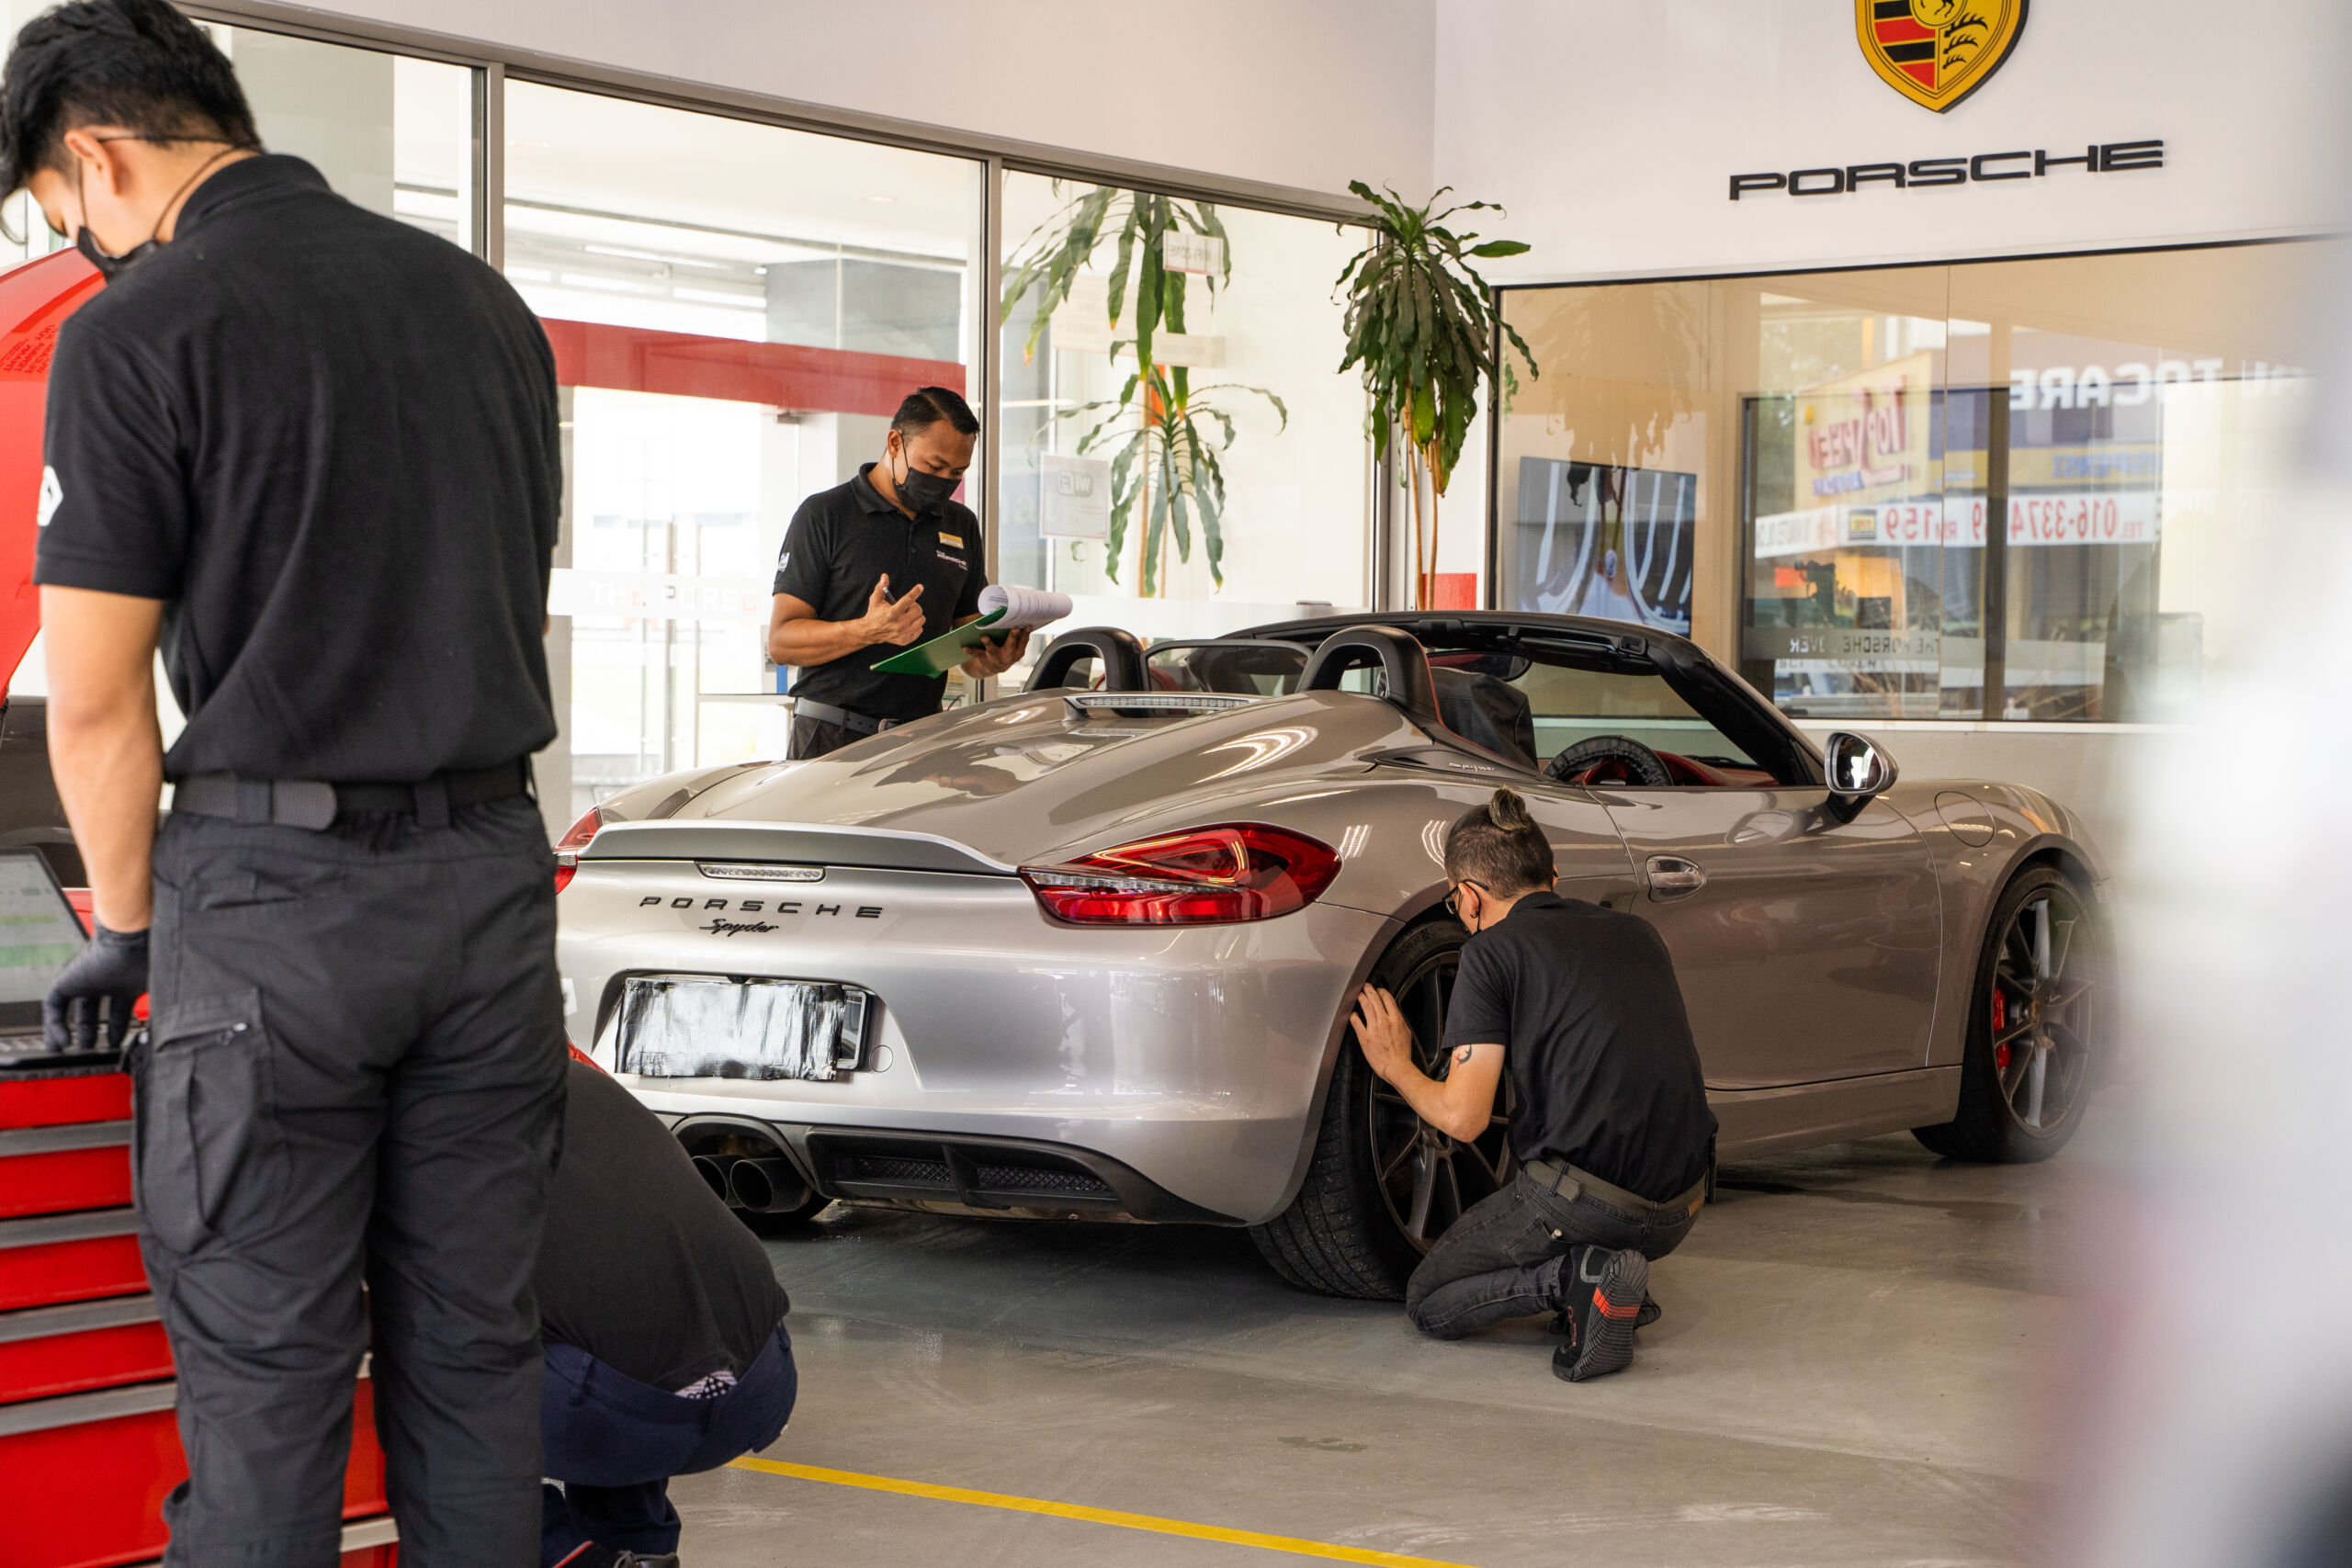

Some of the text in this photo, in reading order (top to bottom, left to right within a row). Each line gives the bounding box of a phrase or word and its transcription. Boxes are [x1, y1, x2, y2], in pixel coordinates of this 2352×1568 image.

[1729, 140, 2164, 200] PORSCHE
[639, 897, 883, 919] PORSCHE
[699, 919, 779, 937] Spyder
